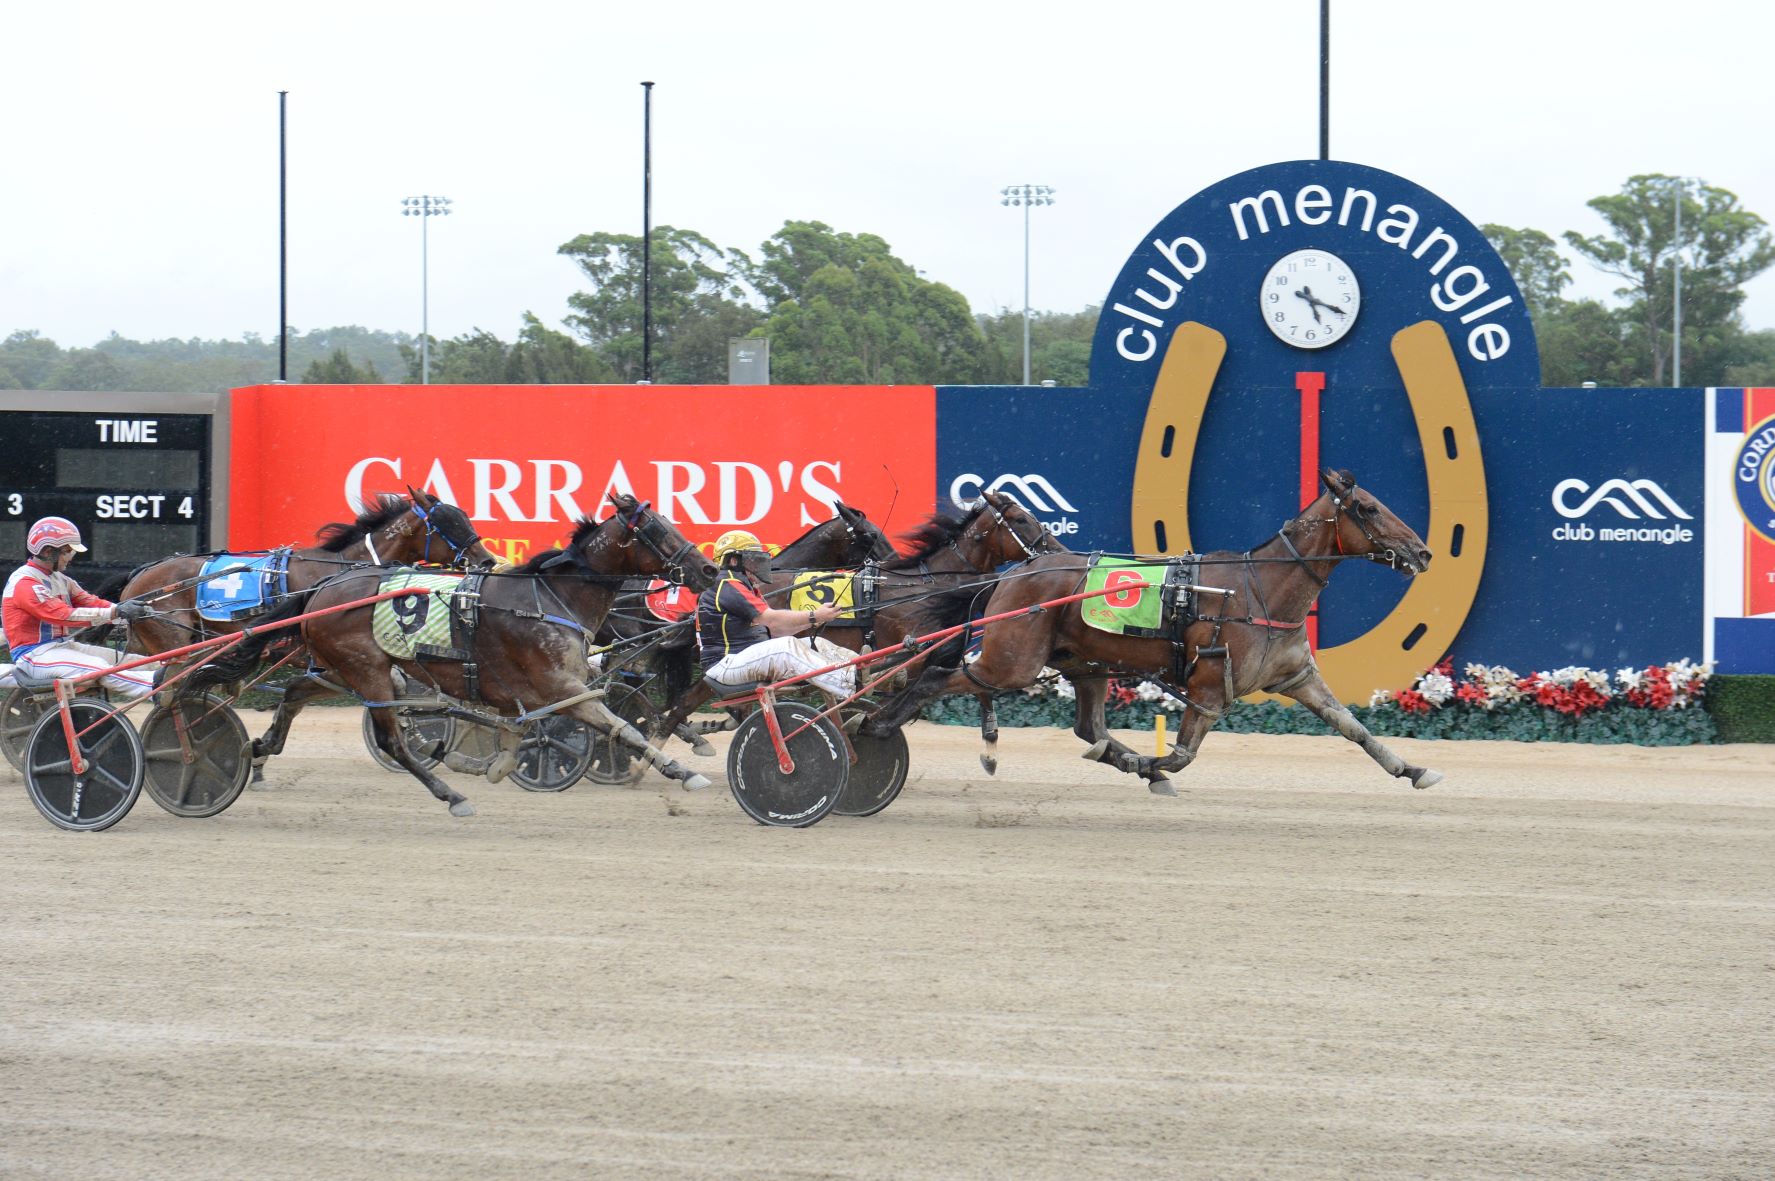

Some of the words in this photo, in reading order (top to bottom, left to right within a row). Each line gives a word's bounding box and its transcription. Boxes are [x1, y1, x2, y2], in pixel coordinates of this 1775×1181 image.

[1113, 236, 1208, 362] club
[1229, 184, 1513, 362] menangle
[1288, 263, 1297, 273] 11
[1276, 275, 1288, 286] 10
[1270, 293, 1279, 304] 9
[1275, 311, 1285, 323] 8
[1290, 325, 1299, 336] 7
[1305, 329, 1316, 340] 6
[1324, 324, 1333, 335] 5
[95, 419, 158, 443] TIME
[7, 493, 24, 516] 3
[96, 495, 166, 518] SECT
[178, 496, 194, 518] 4
[1552, 522, 1595, 541] club
[1599, 523, 1694, 545] menangle
[207, 562, 246, 599] 4
[806, 575, 836, 605] 5
[1104, 570, 1144, 609] 6
[392, 590, 430, 636] 9
